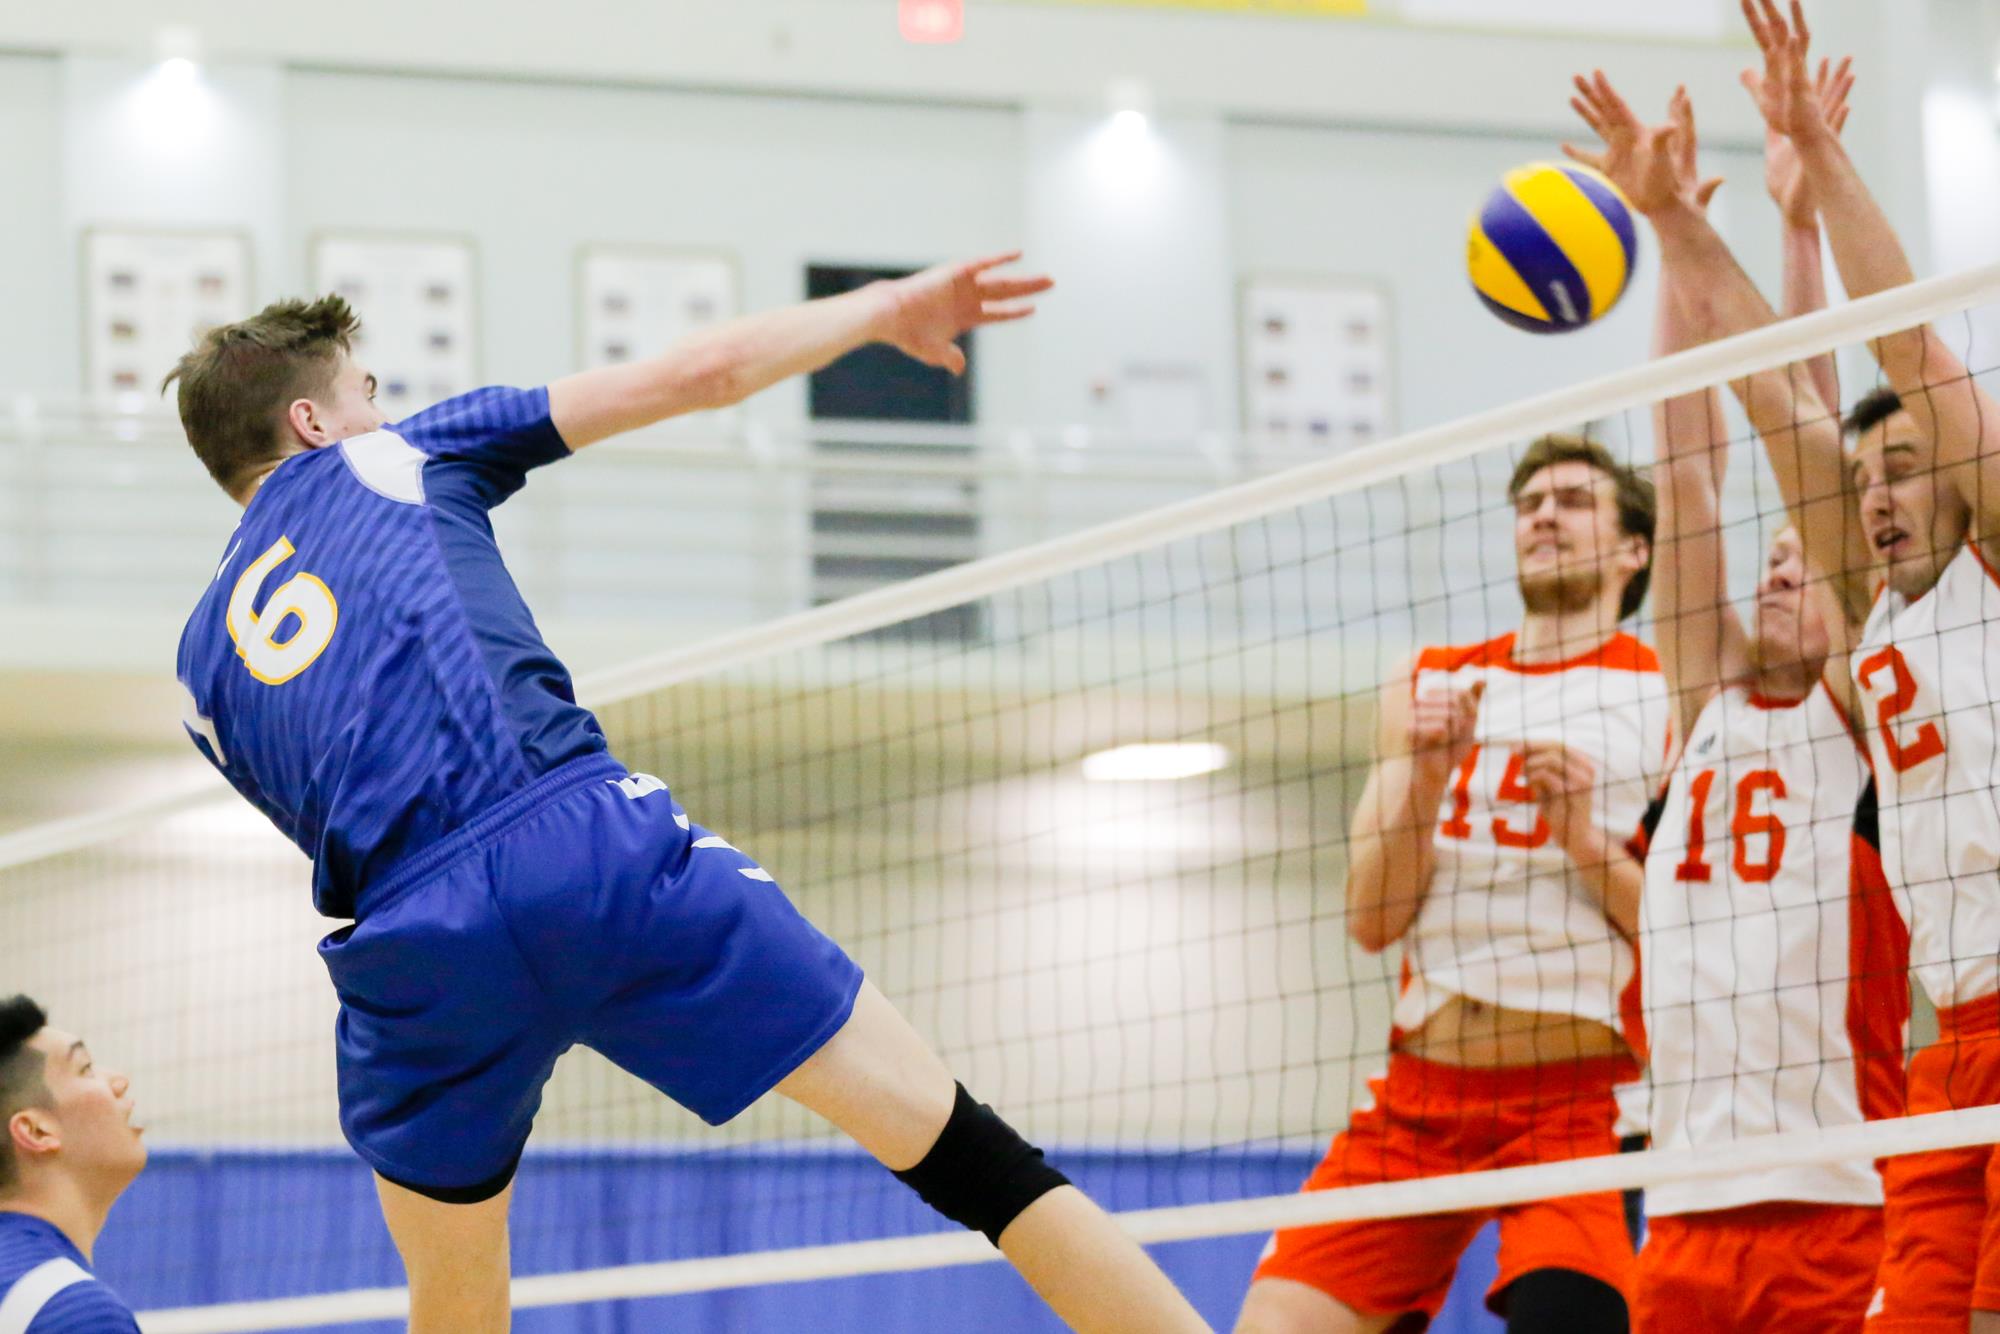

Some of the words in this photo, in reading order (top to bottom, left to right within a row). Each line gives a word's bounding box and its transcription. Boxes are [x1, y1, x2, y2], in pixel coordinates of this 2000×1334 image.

[227, 535, 338, 685] 6
[1857, 645, 1945, 772] 2
[1441, 743, 1552, 849] 15
[1675, 769, 1788, 883] 16
